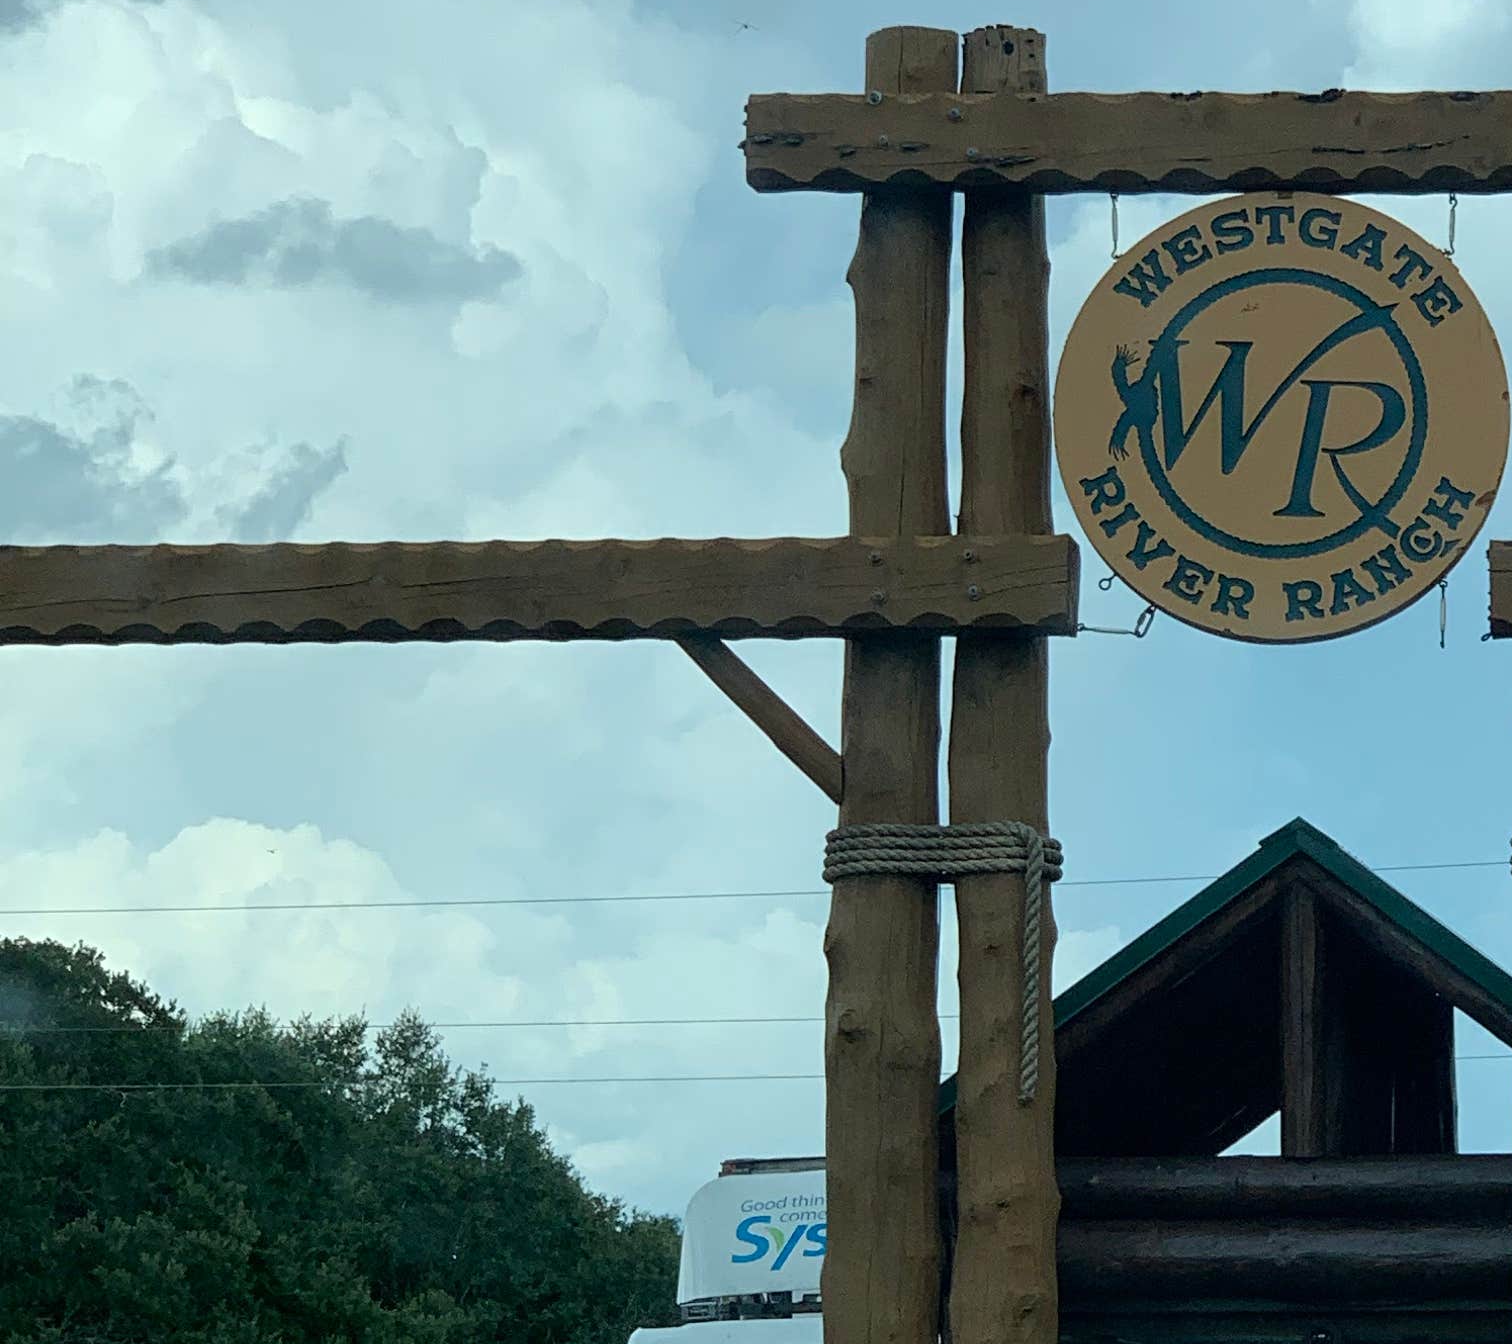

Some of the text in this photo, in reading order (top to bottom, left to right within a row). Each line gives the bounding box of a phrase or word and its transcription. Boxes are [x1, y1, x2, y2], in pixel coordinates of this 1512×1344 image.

[1113, 205, 1463, 327] WESTGATE
[1149, 303, 1406, 538] WR
[1079, 465, 1476, 623] RIVER RANCH
[731, 1215, 829, 1272] Sys
[740, 1195, 788, 1213] Good
